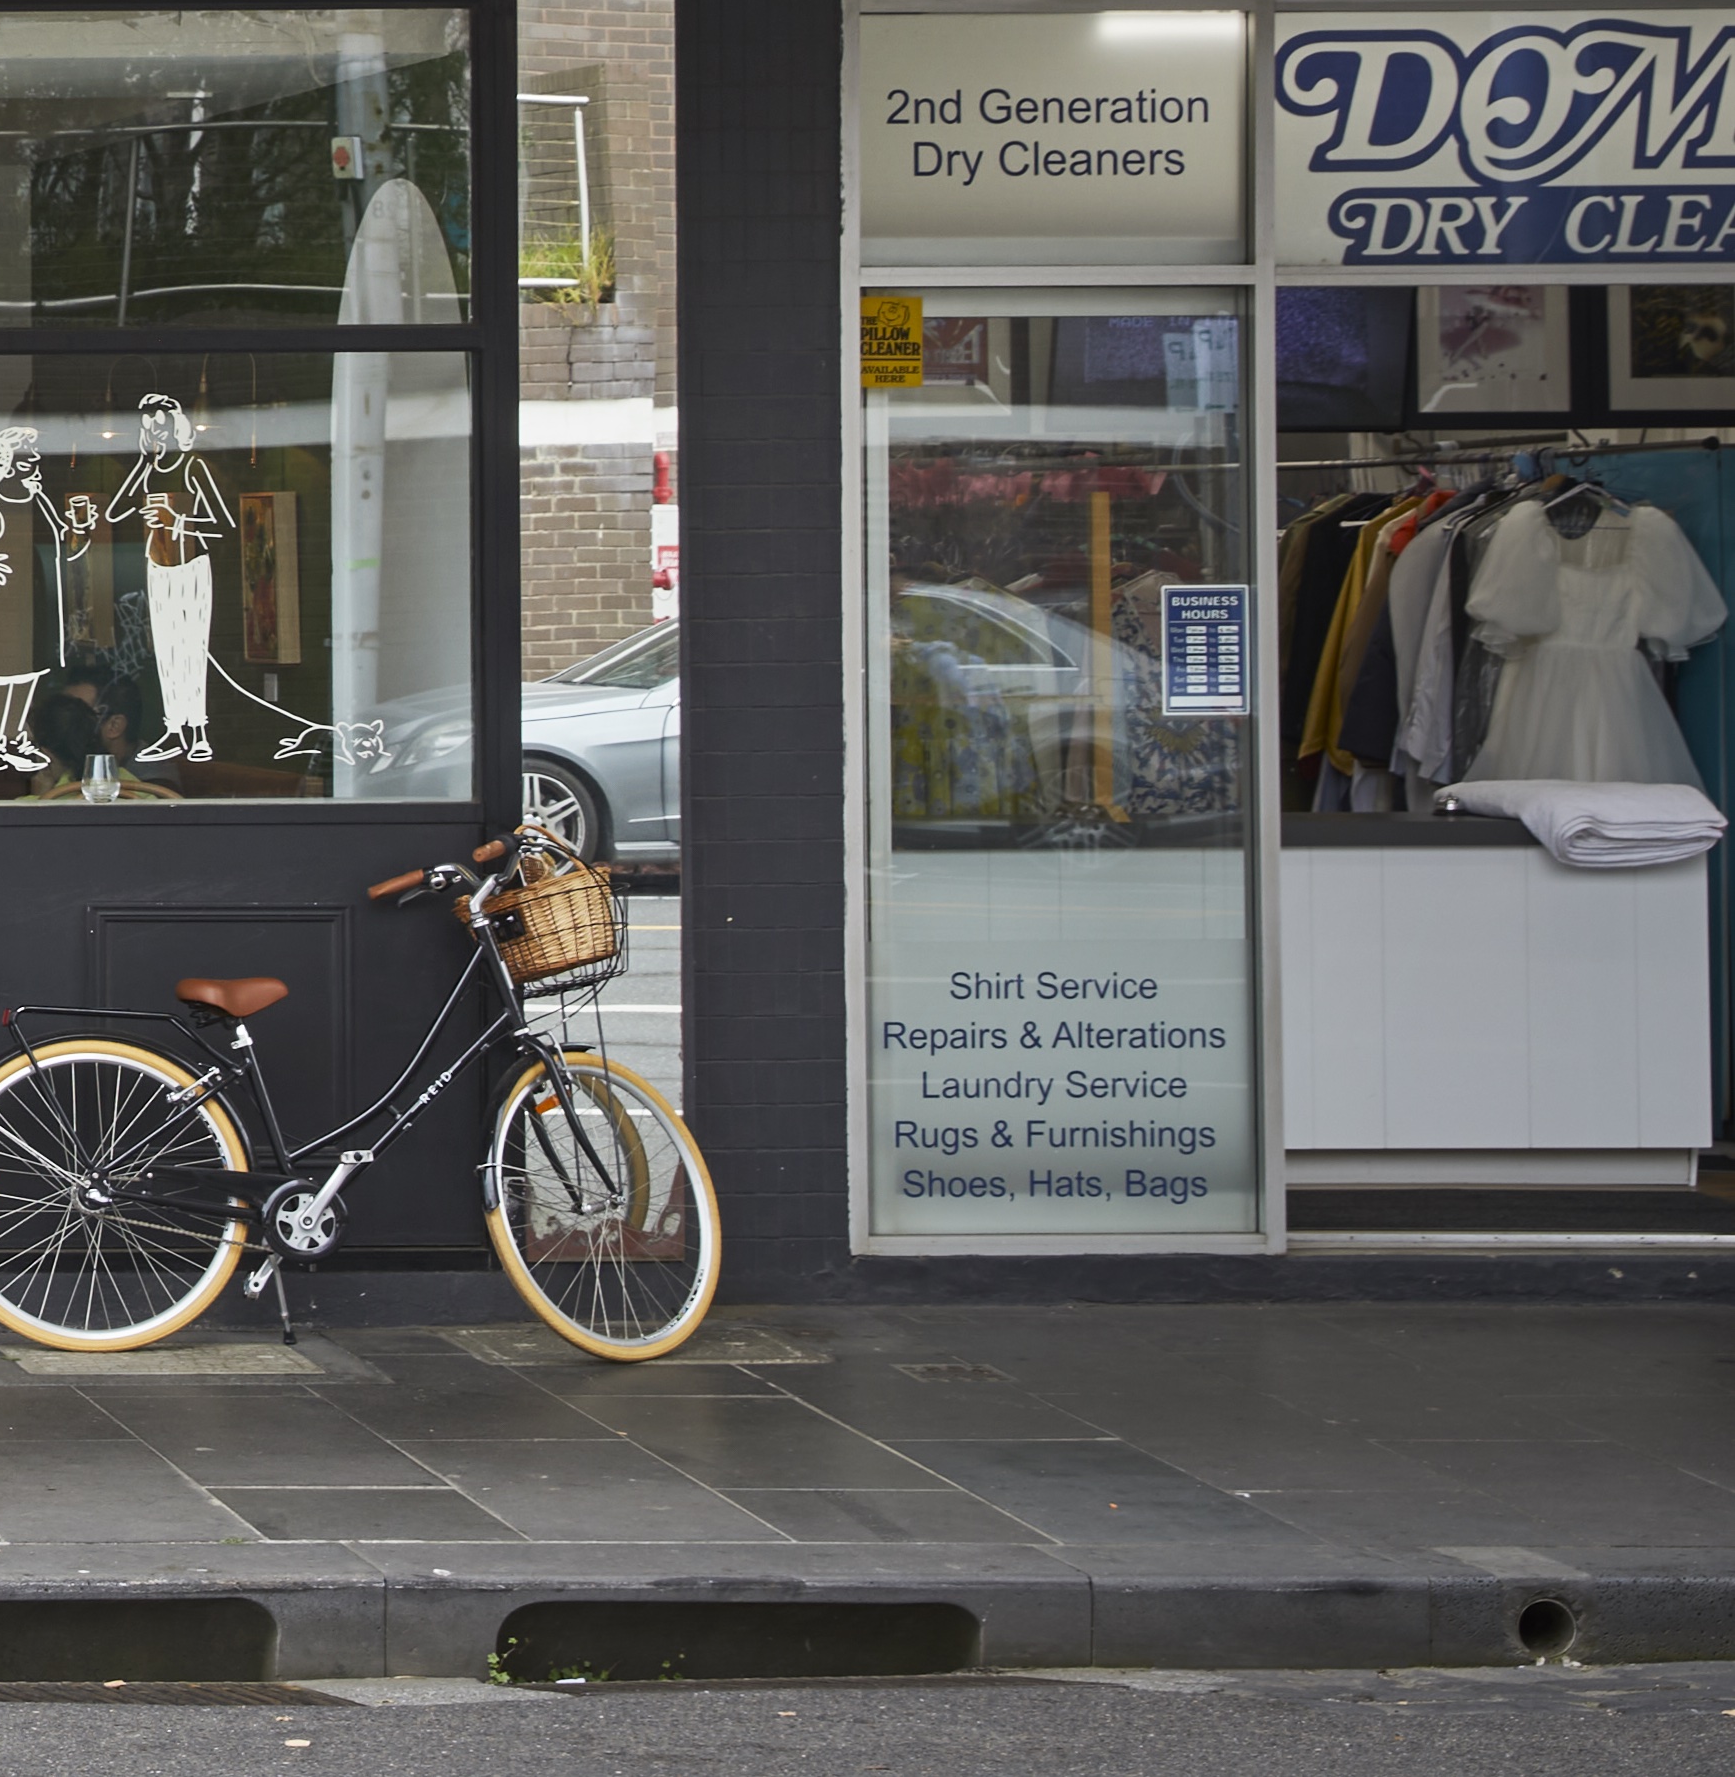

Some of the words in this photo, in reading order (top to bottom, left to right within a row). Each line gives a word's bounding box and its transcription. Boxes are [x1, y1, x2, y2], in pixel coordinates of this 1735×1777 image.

[885, 88, 962, 124] 2nd
[979, 88, 1209, 124] Generation
[913, 141, 984, 187] Dry
[998, 140, 1186, 176] Cleaners
[1339, 195, 1529, 256] DRY
[860, 316, 878, 325] THE
[860, 327, 911, 341] PILLOW
[860, 341, 921, 356] CLEANER
[860, 365, 920, 374] AVAILABLE
[875, 375, 906, 383] HERE
[1171, 596, 1239, 606] BUSINESS
[1181, 609, 1229, 619] HOURS
[949, 971, 1025, 1000] Shirt
[1036, 971, 1158, 1000] Service
[883, 1021, 1008, 1057] Repairs
[1019, 1021, 1043, 1050] &
[1051, 1021, 1227, 1050] Alterations
[418, 1071, 452, 1104] REID
[922, 1070, 1054, 1106] Laundry
[1065, 1070, 1188, 1099] Service
[894, 1120, 979, 1157] Rugs
[990, 1120, 1015, 1149] &
[1026, 1119, 1217, 1156] Furnishings
[901, 1169, 1017, 1202] Shoes,
[1028, 1169, 1112, 1202] Hats,
[1124, 1169, 1209, 1205] Bags
